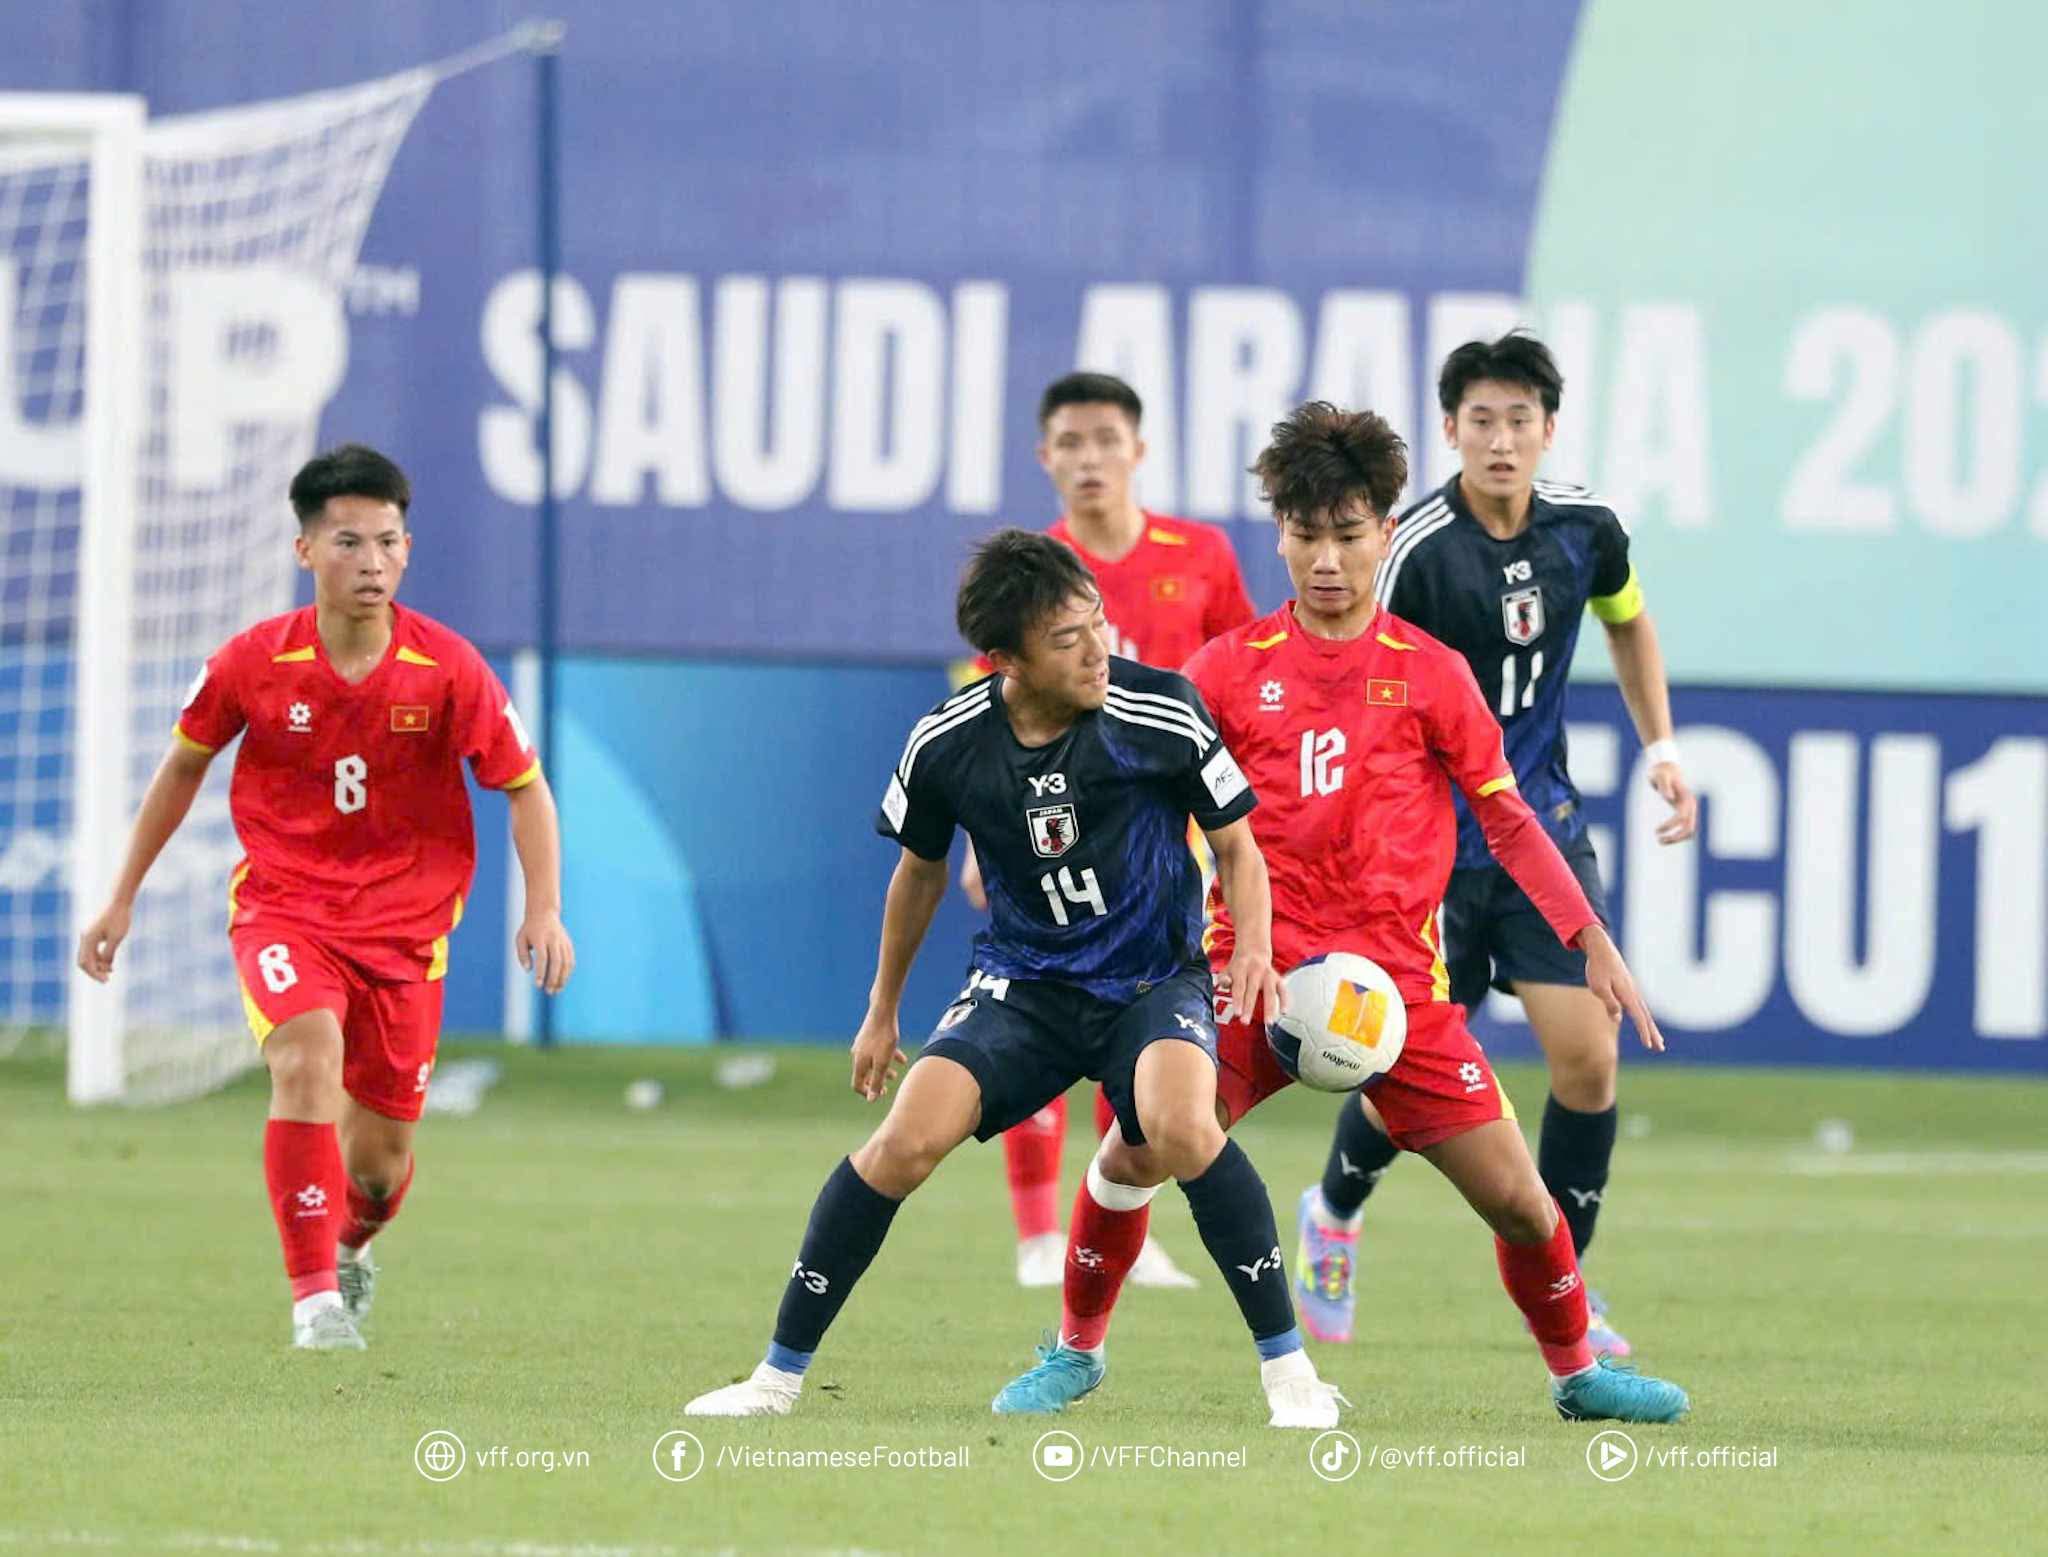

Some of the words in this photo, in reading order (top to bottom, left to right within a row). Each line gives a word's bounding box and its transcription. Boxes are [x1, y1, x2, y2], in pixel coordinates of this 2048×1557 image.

[478, 270, 1008, 512] SAUDI
[1776, 305, 2048, 538] 20
[1500, 650, 1544, 716] 11
[334, 754, 368, 814] 8
[1028, 772, 1067, 798] Y-3
[1300, 726, 1347, 798] 12
[1040, 865, 1108, 926] 14
[258, 943, 298, 993] 8
[1235, 1246, 1281, 1282] Y-3
